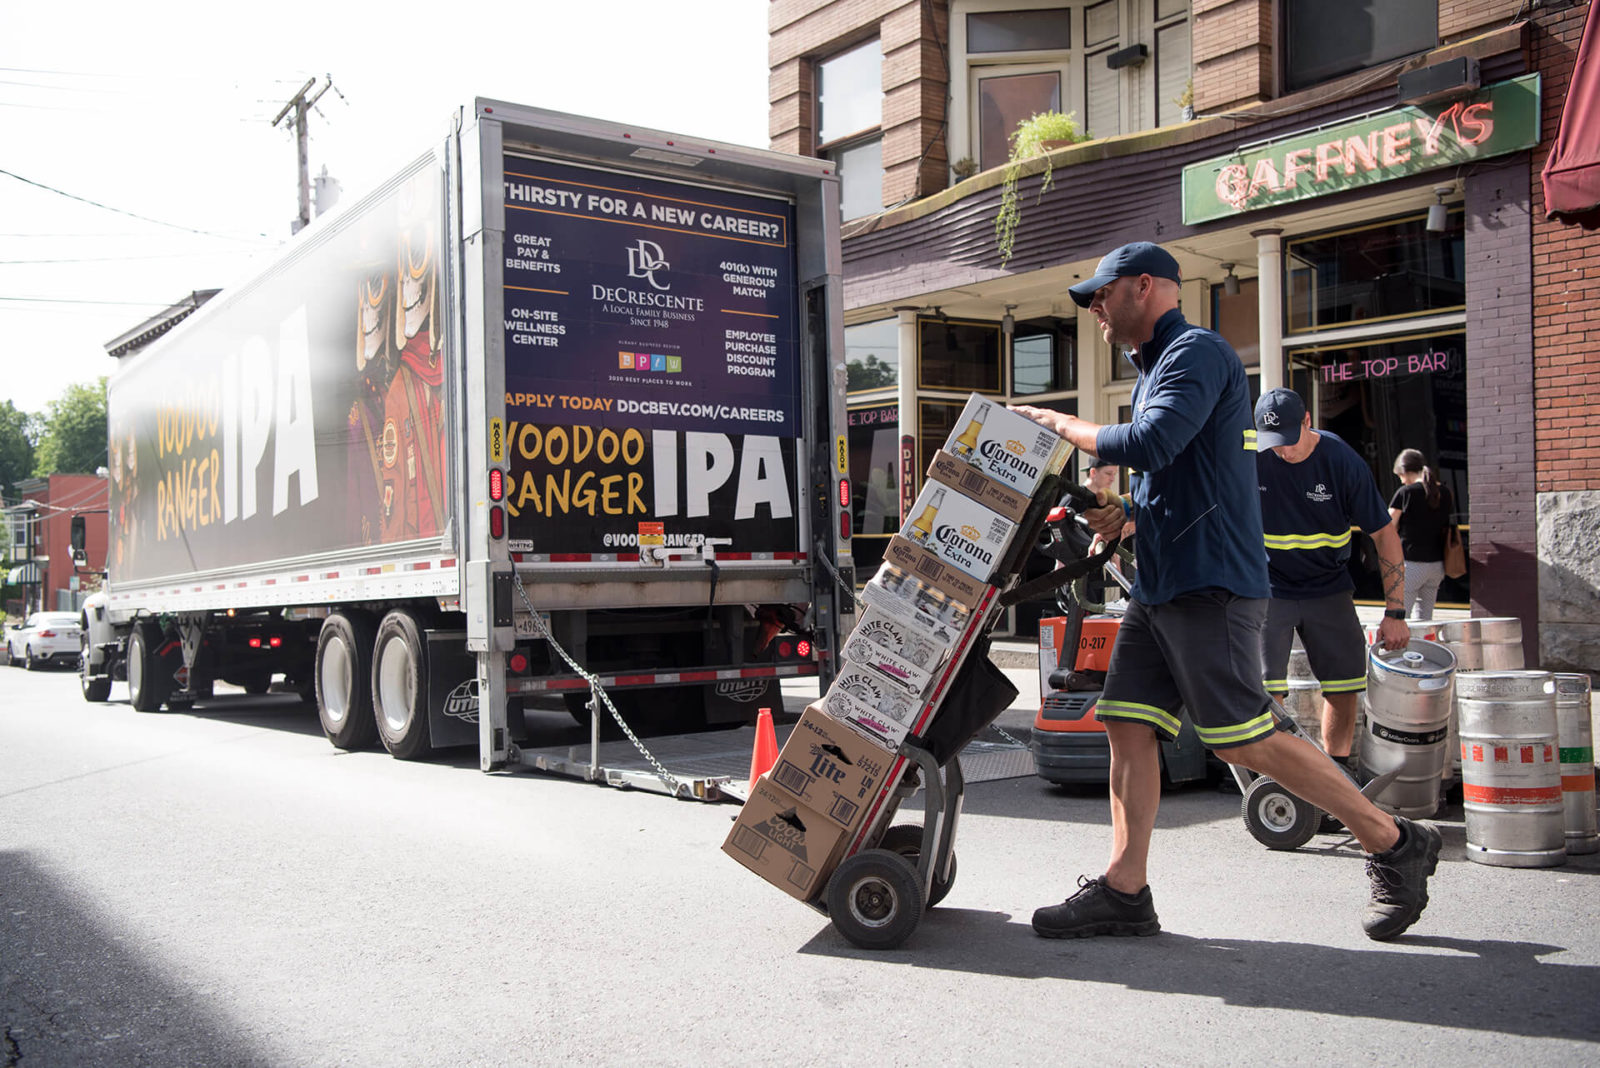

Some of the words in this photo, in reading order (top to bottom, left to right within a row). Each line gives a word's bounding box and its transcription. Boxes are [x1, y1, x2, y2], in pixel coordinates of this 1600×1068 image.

[1215, 101, 1495, 211] GAFFNEY'S
[503, 182, 583, 208] THIRSTY
[588, 195, 628, 216] FOR
[632, 202, 647, 219] A
[651, 205, 696, 226] NEW
[700, 213, 779, 239] CAREER?
[514, 234, 552, 247] GREAT
[517, 247, 539, 259] PAY
[541, 250, 550, 259] &
[506, 258, 561, 273] BENEFITS
[720, 261, 750, 274] 401(k)
[752, 265, 778, 277] WITH
[723, 273, 776, 288] GENEROUS
[733, 286, 766, 298] MATCH
[592, 284, 704, 312] DECRESCENTE
[511, 308, 558, 321] ON-SITE
[602, 304, 609, 312] A
[611, 305, 634, 316] LOCAL
[636, 307, 661, 318] FAMILY
[663, 311, 696, 321] BUSINESS
[630, 317, 651, 327] SINCE
[653, 319, 669, 328] 1948
[504, 320, 566, 335] WELLNESS
[725, 330, 776, 343] EMPLOYEE
[513, 334, 558, 347] CENTER
[725, 341, 777, 355] PURCHASE
[726, 353, 776, 366] DISCOUNT
[727, 365, 775, 377] PROGRAM
[1321, 363, 1353, 383] THE
[1361, 357, 1398, 378] TOP
[1408, 352, 1447, 373] BAR
[223, 303, 319, 525] IPA
[504, 392, 555, 408] APPLY
[559, 395, 613, 412] TODAY
[617, 399, 785, 423] DDCBEV.COM/CAREERS
[860, 411, 877, 425] TOP
[881, 407, 899, 423] BAR
[493, 422, 501, 457] MAXON
[980, 440, 1038, 480] Corona
[988, 459, 1017, 484] Extra
[652, 429, 793, 520] IPA
[157, 448, 221, 541] RANGER
[506, 469, 647, 518] RANGER
[935, 524, 993, 565] Corona
[943, 544, 972, 568] Extra
[883, 622, 903, 645] CLAW
[1079, 637, 1106, 649] 0-217
[875, 651, 898, 666] WHITE
[899, 664, 919, 678] CLAW
[861, 676, 882, 699] CLAW
[854, 705, 876, 720] WHITE
[877, 719, 898, 733] CLAW
[809, 754, 847, 784] Lite
[861, 775, 873, 789] LN
[768, 827, 797, 850] LIGHT
